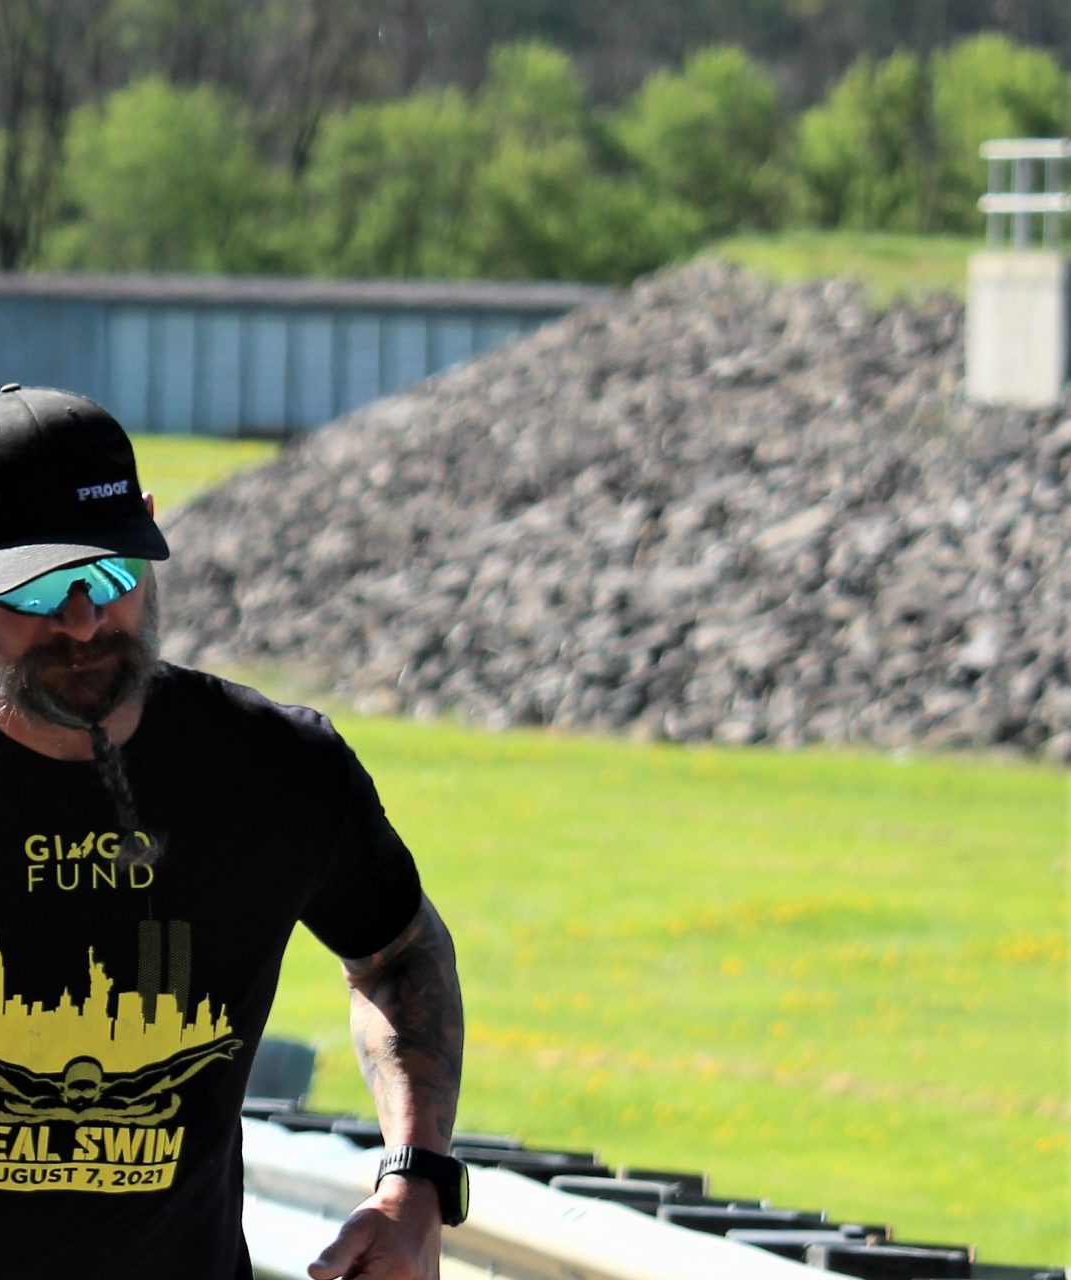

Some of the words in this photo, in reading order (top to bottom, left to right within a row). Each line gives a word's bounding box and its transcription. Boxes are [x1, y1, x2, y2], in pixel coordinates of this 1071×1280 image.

[76, 479, 128, 501] PROOF
[27, 862, 155, 892] FUND
[72, 1126, 184, 1164] SWIM
[85, 1168, 103, 1189] 7,
[110, 1168, 164, 1187] 2021
